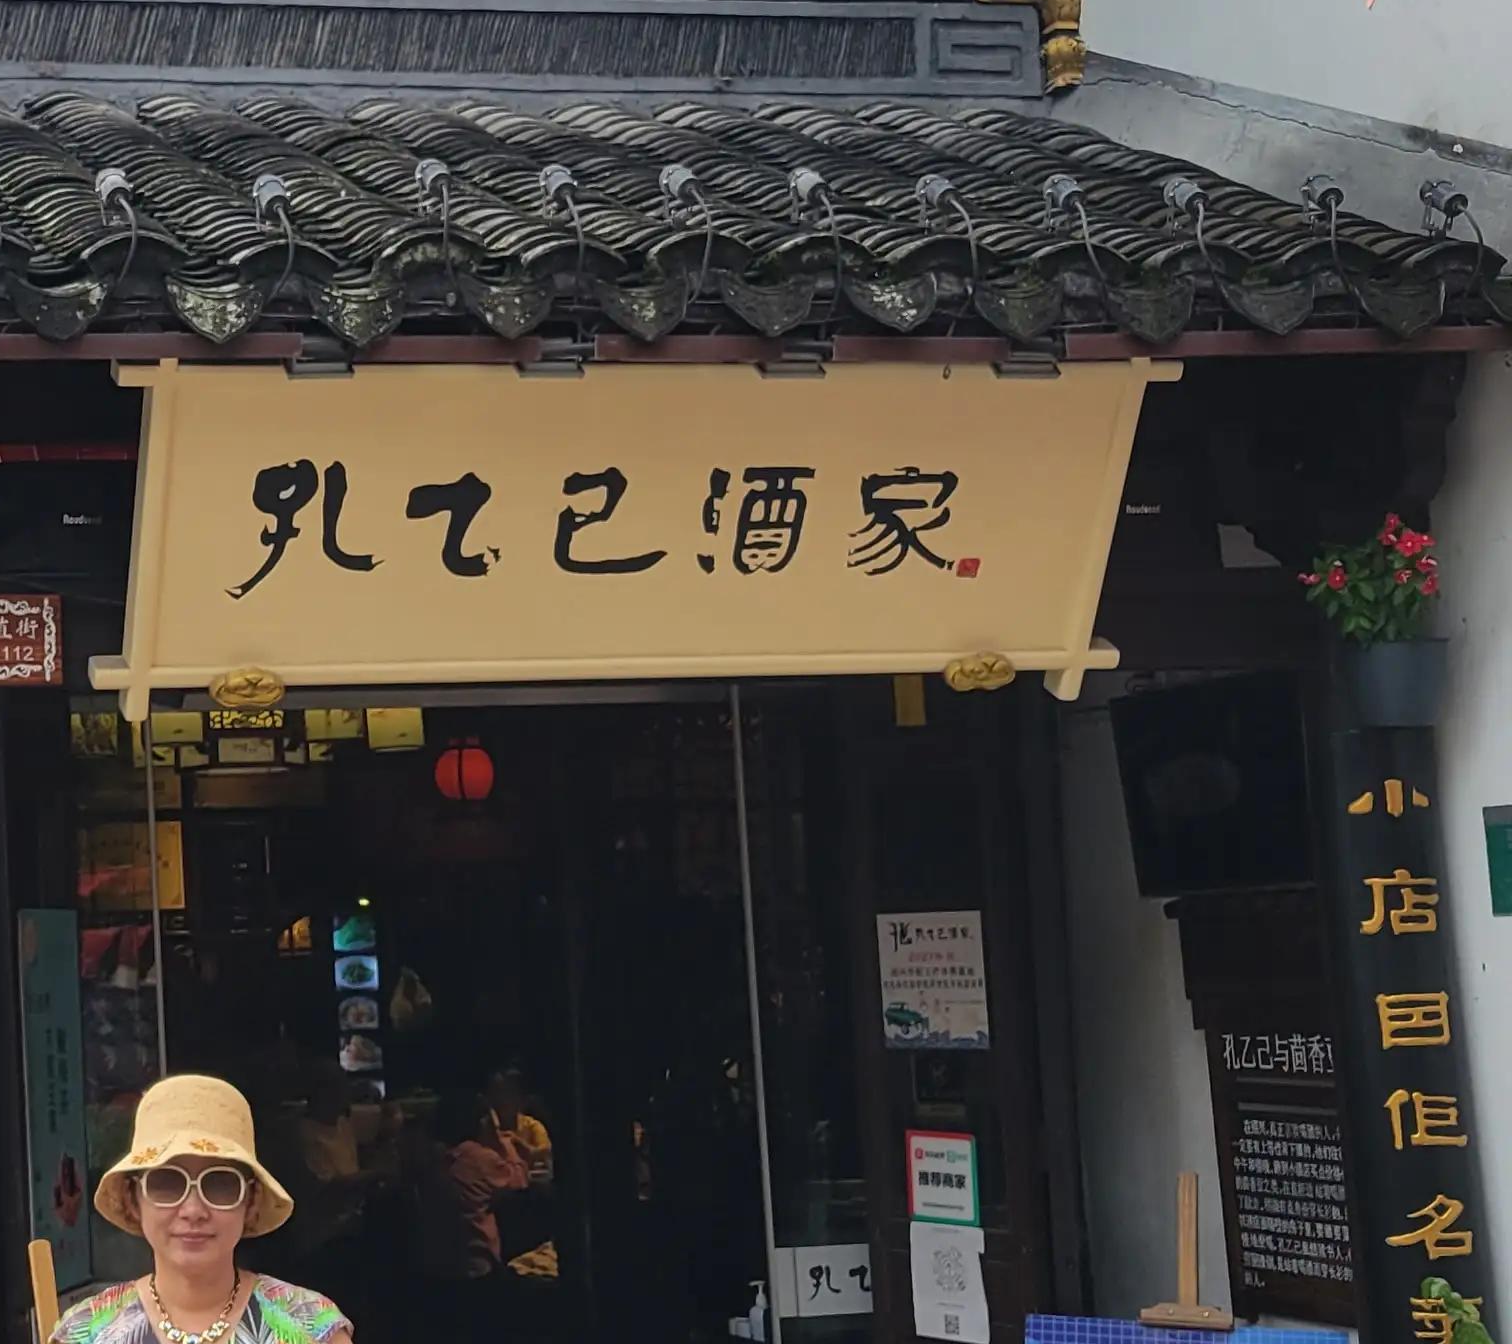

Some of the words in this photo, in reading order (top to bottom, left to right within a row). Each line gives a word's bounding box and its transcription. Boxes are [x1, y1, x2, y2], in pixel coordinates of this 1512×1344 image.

[224, 457, 960, 600] 孔乙己酒家
